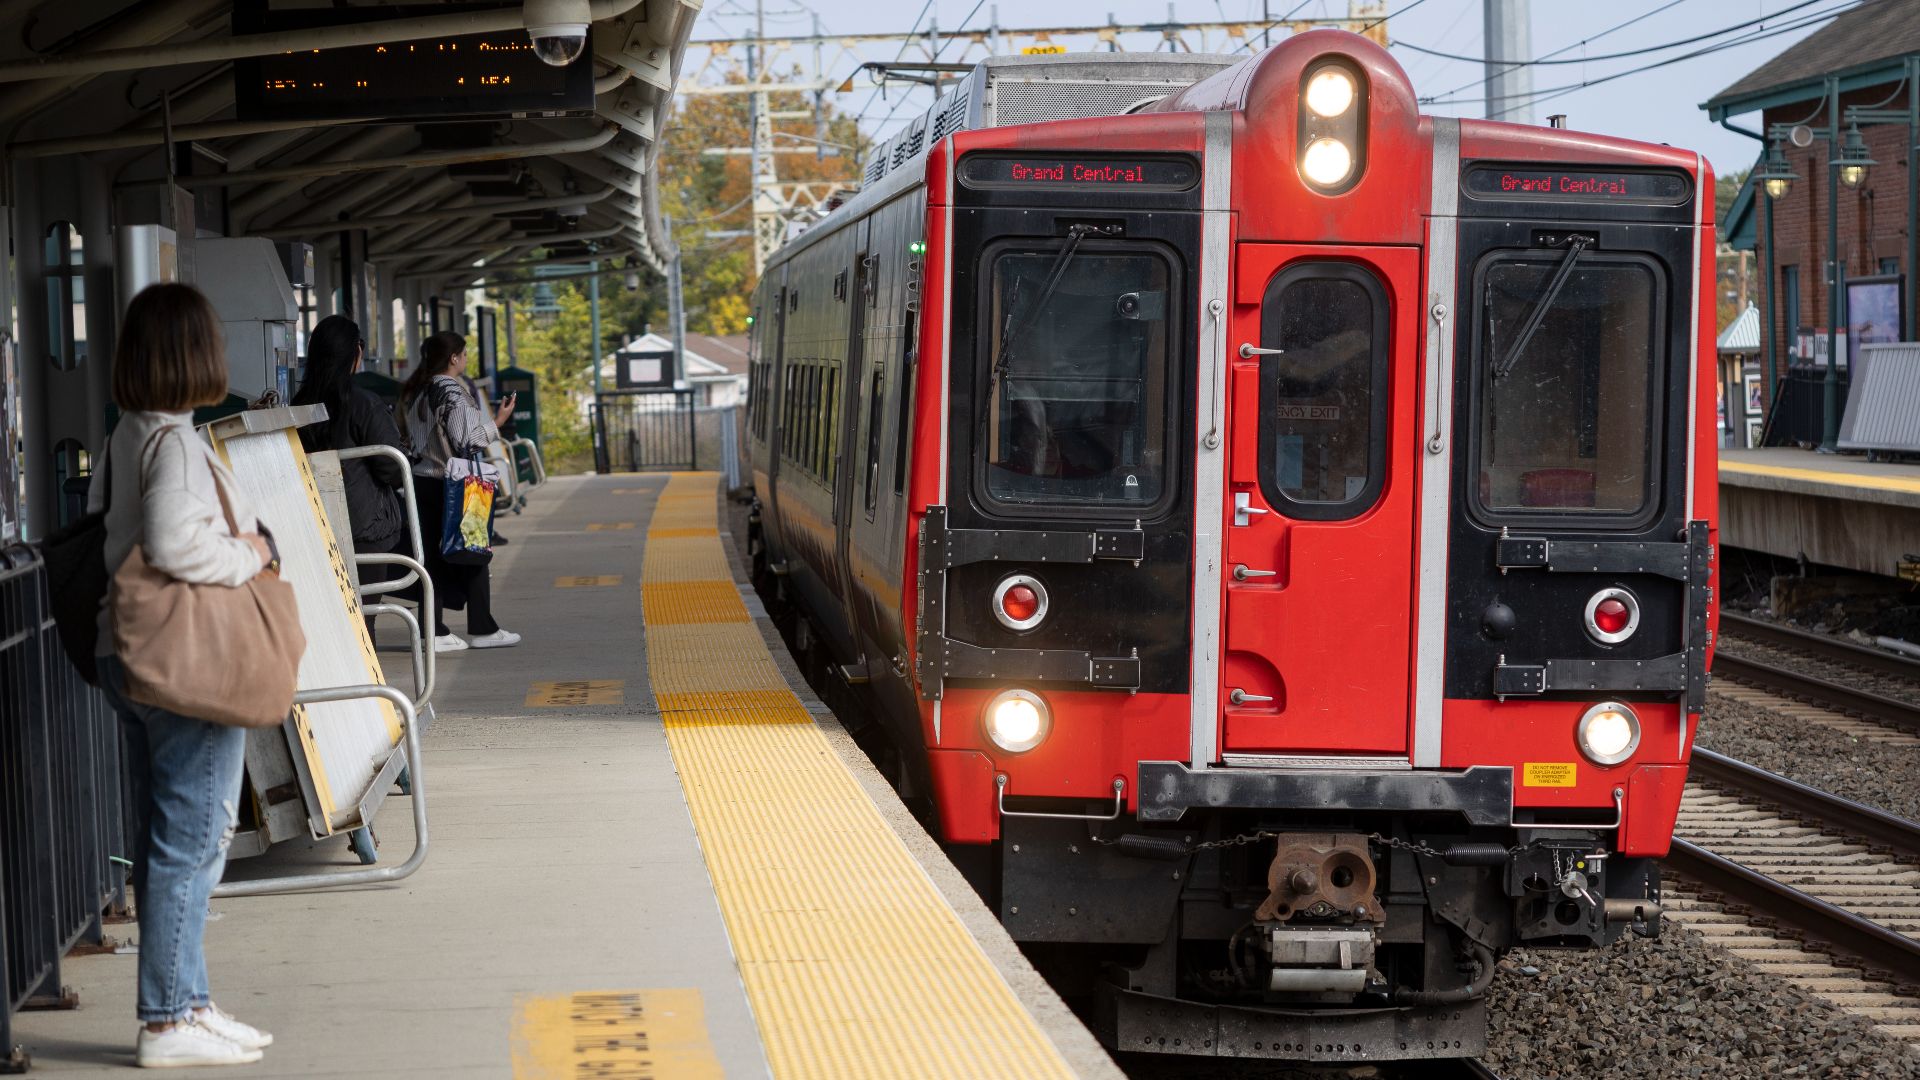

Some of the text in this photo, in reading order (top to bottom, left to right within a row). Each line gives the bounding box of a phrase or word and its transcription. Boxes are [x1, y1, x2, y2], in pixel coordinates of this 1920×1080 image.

[1012, 163, 1143, 182] Grand Central
[1501, 175, 1626, 194] Grand Central
[1310, 407, 1338, 419] EXIT
